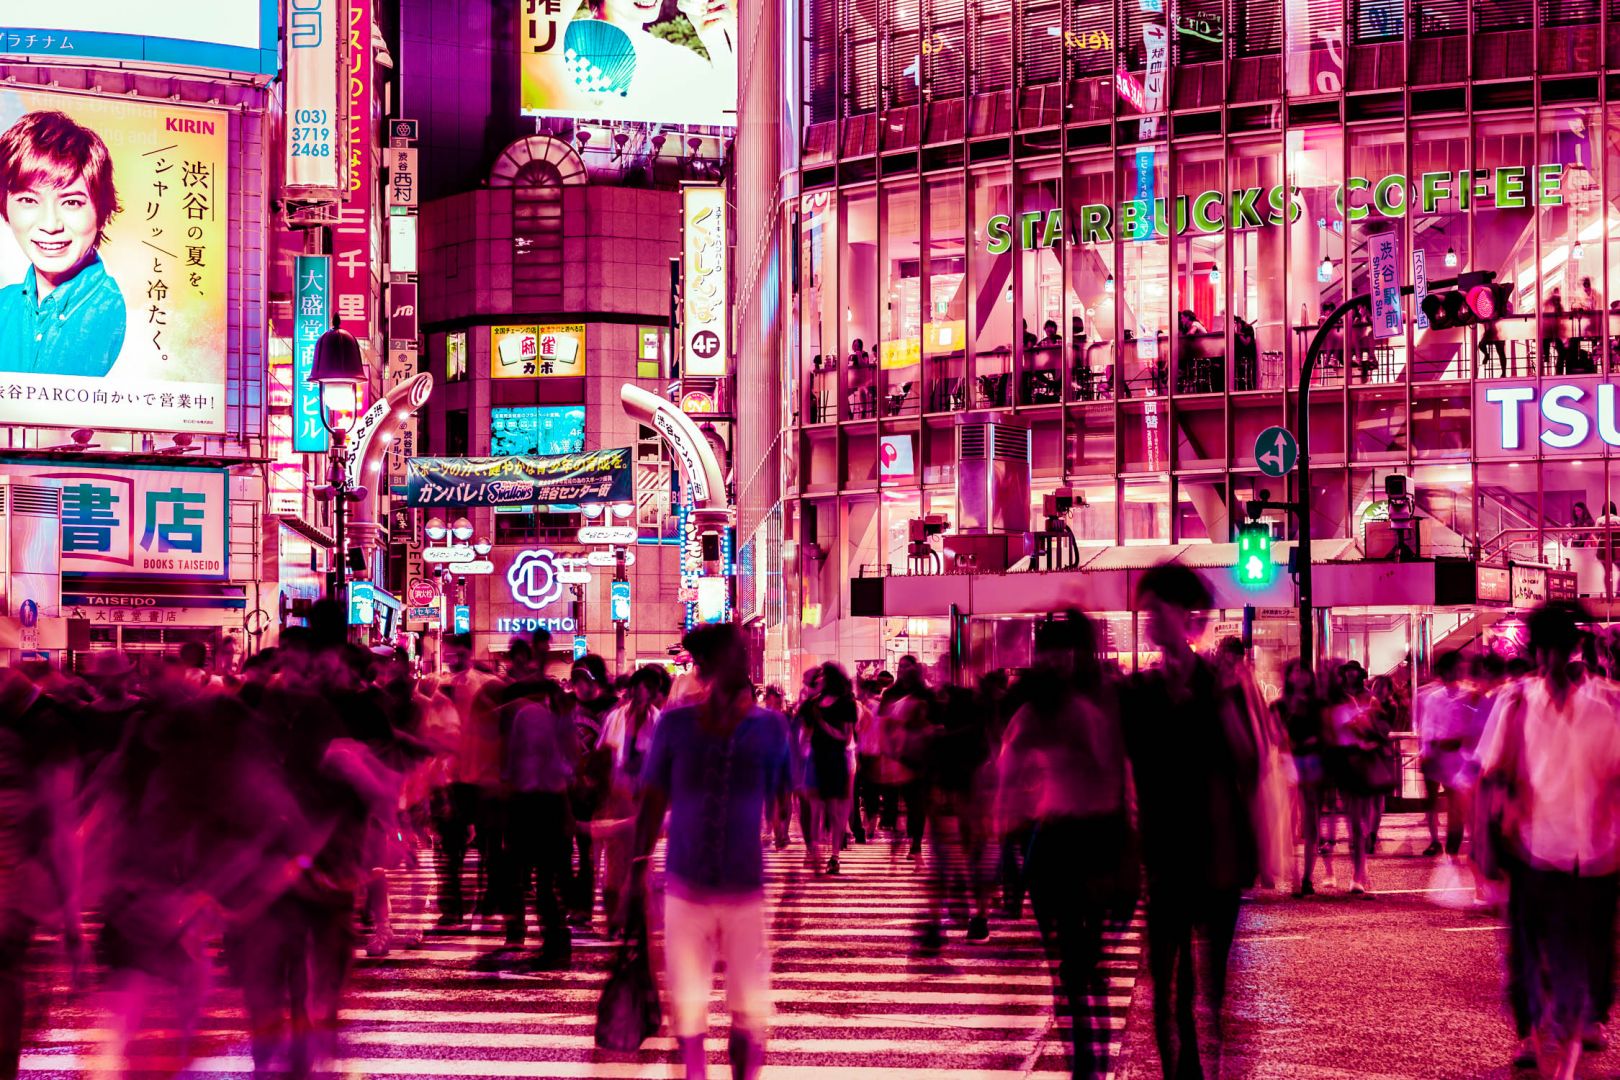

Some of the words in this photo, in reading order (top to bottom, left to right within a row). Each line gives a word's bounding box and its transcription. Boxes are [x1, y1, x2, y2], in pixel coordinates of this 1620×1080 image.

[295, 110, 327, 125] (03)
[166, 117, 215, 135] KIRIN
[292, 128, 329, 141] 3719
[291, 143, 330, 157] 2468
[394, 152, 412, 202] 渋谷西村
[986, 184, 1303, 255] STARBUCKS
[1335, 163, 1564, 221] COFFEE
[1373, 257, 1381, 297] Shibuya
[1380, 241, 1399, 328] 渋谷駅前
[393, 304, 414, 318] JTB
[693, 335, 718, 354] 4F
[418, 482, 486, 502] ガンバレ!
[537, 484, 612, 500] 渋谷センター街
[62, 484, 206, 553] 書店
[143, 558, 174, 570] BOOKS
[178, 559, 220, 571] TAISEIDO
[86, 596, 157, 606] TAISEIDO
[95, 609, 177, 623] 大盛堂書店
[498, 617, 574, 632] ITS'DEMO
